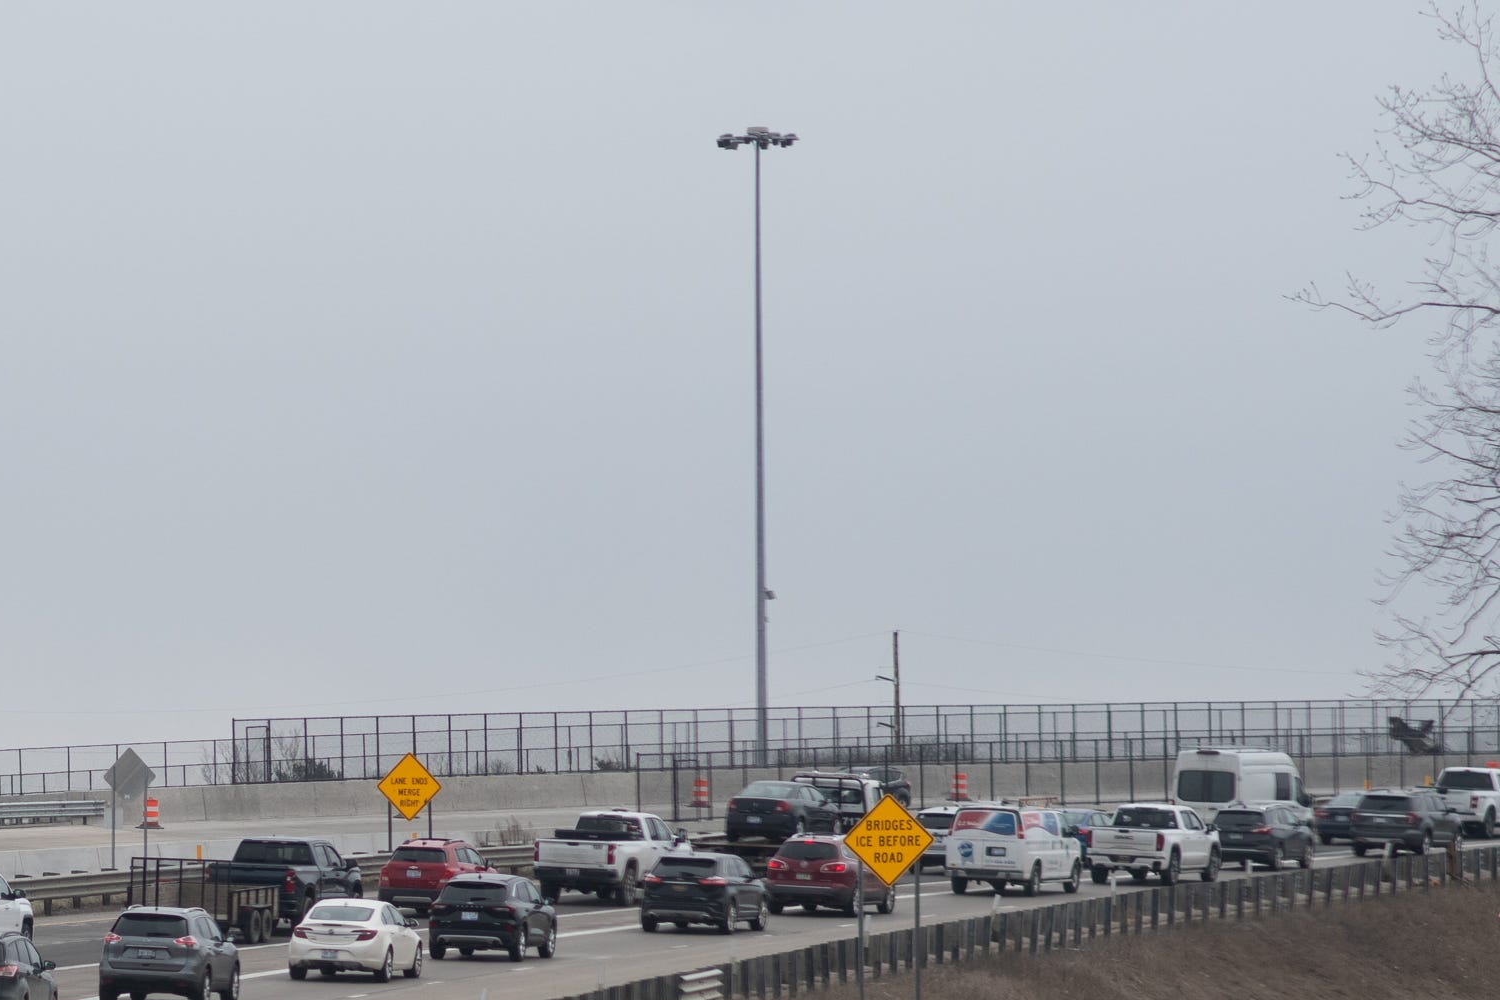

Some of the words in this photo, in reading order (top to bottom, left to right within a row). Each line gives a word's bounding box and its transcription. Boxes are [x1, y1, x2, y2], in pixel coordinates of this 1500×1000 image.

[390, 777, 407, 785] LANE
[411, 777, 428, 785] ENDS
[398, 788, 420, 796] MERGE
[399, 799, 419, 807] RIGHT
[866, 819, 913, 831] BRIDGES
[855, 836, 873, 847] ICE
[878, 835, 921, 847] BEFORE
[874, 852, 903, 863] ROAD
